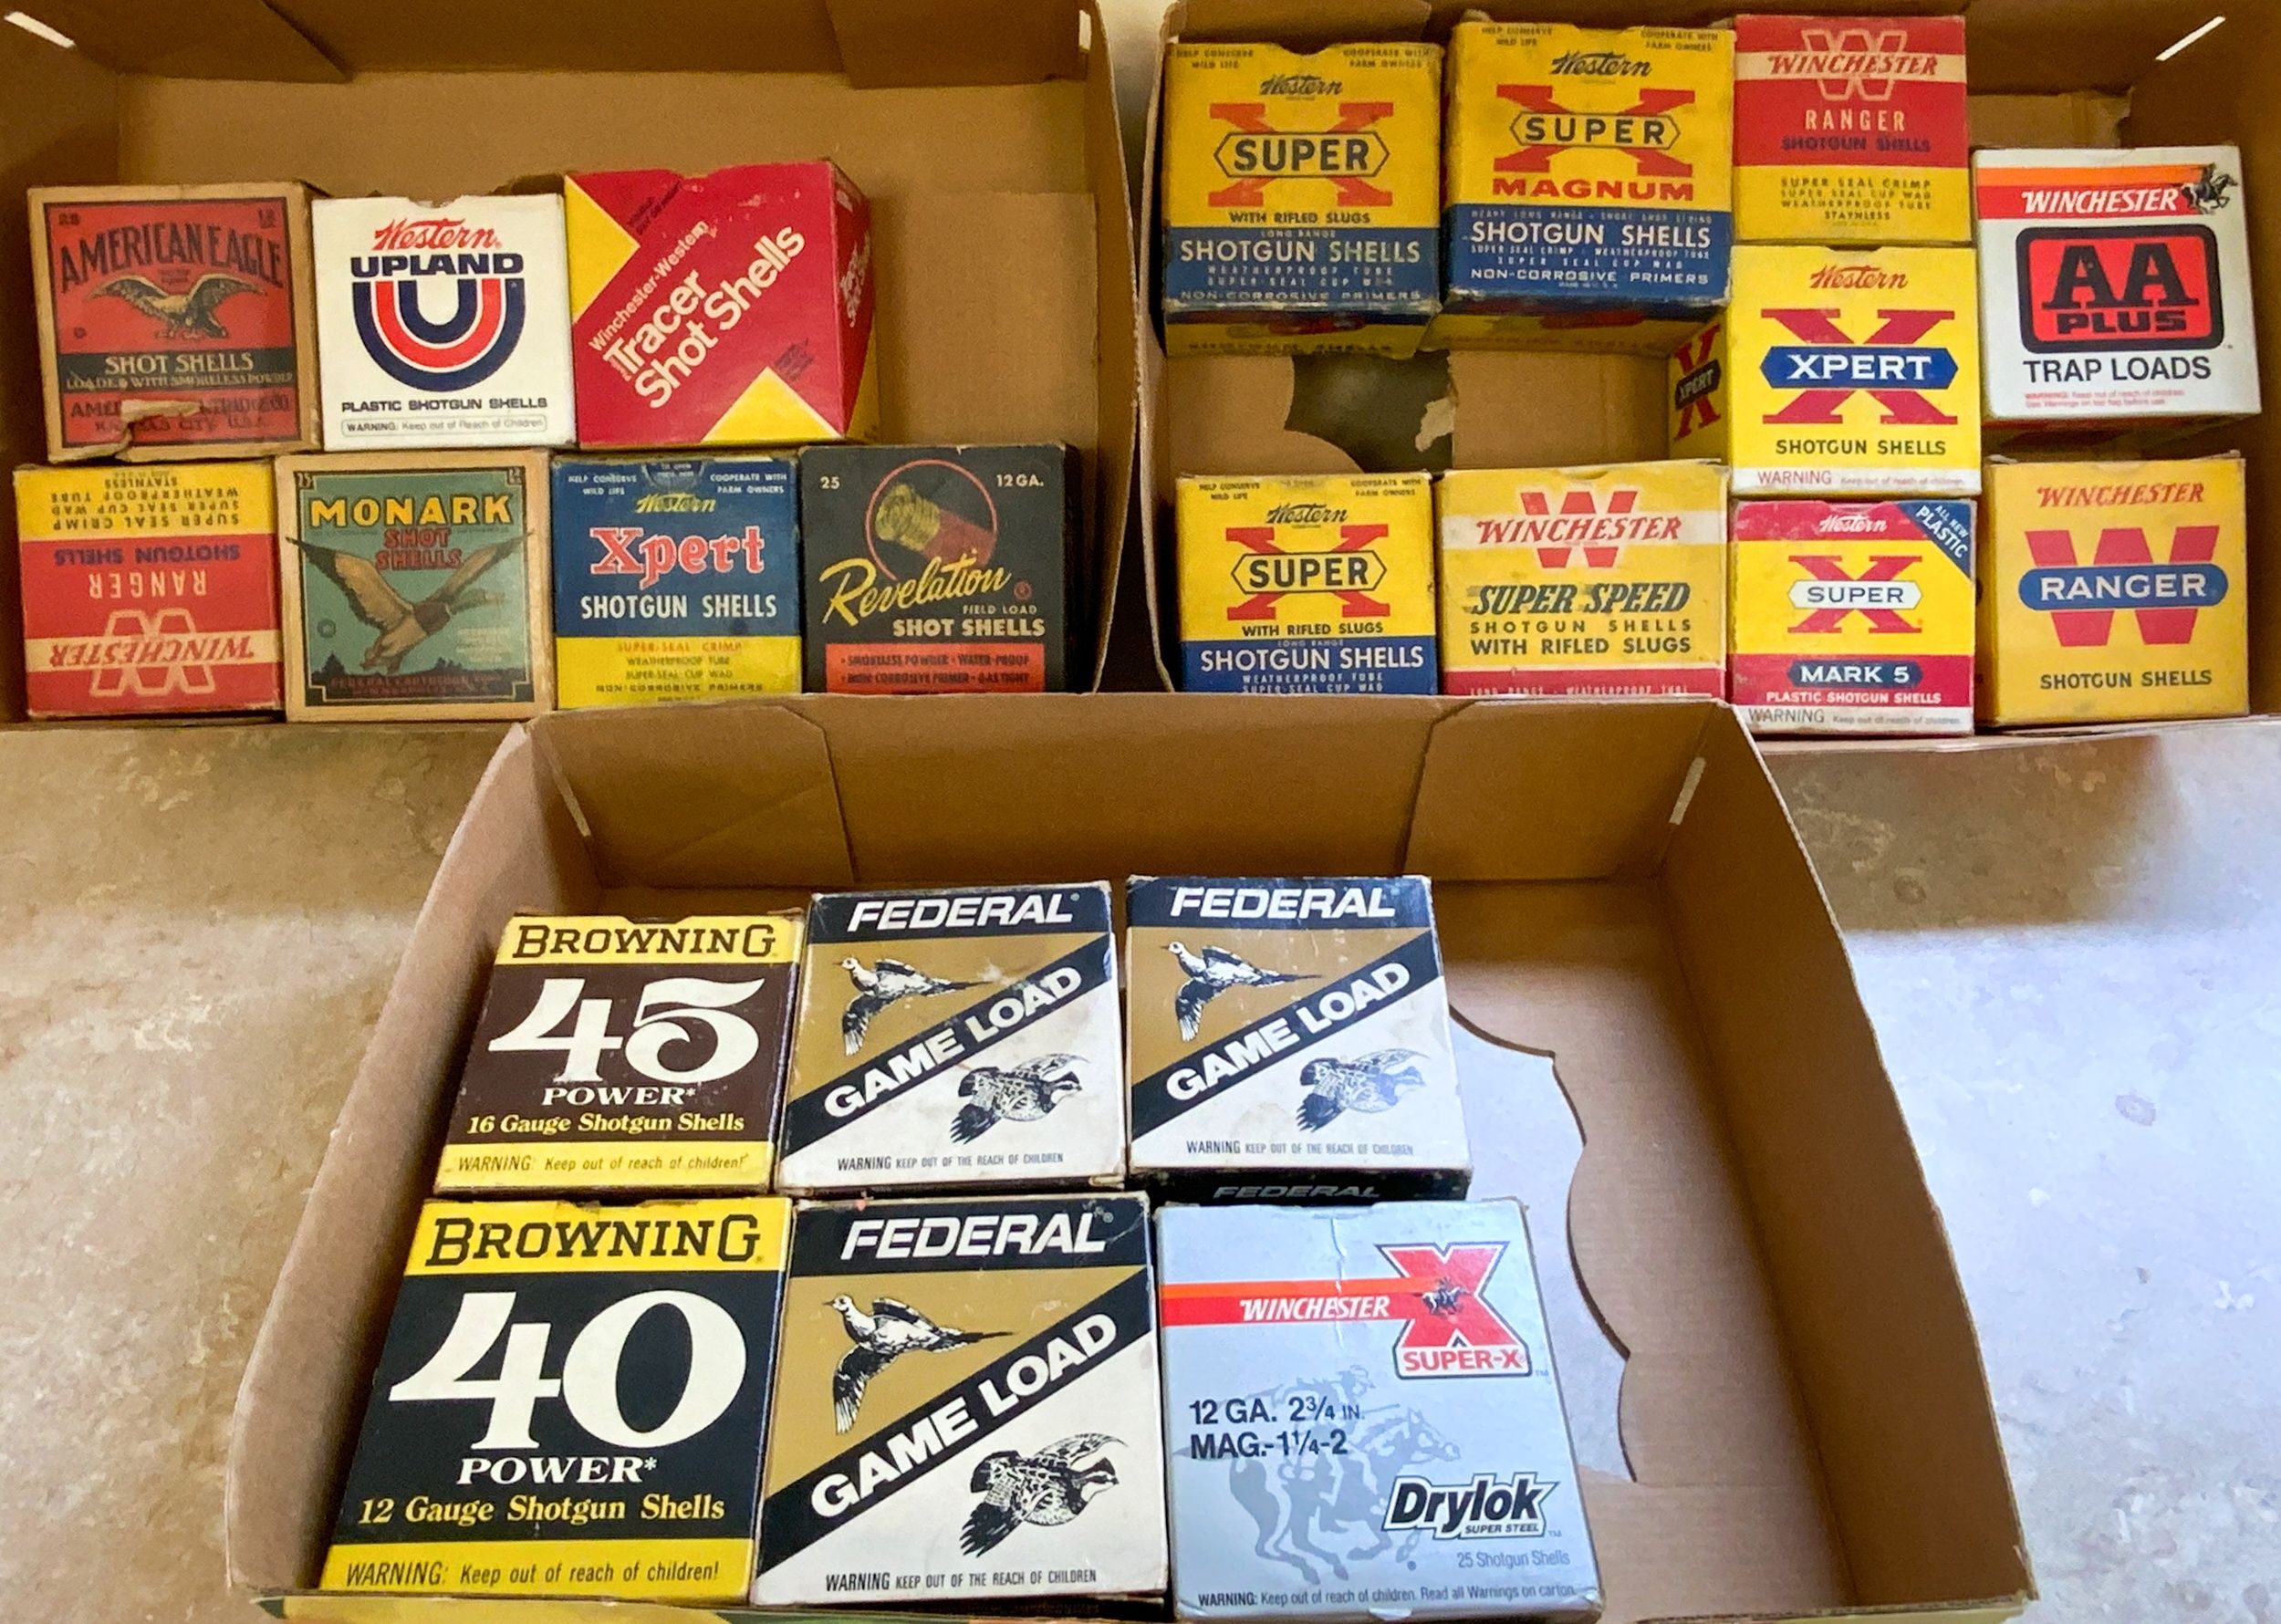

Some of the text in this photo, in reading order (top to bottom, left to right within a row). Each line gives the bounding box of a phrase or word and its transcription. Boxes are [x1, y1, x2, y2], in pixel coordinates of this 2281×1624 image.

[1768, 55, 1938, 75] WINCHESTER
[1526, 118, 1664, 144] SUPER
[1806, 109, 1905, 131] RANGER
[1234, 139, 1369, 171] SUPER
[1493, 179, 1693, 201] MAGNUM
[2021, 188, 2179, 213] WINCHESTER
[1231, 213, 1370, 223] WITH RIFLED SLUGS
[371, 218, 498, 250] Western
[1471, 222, 1710, 248] SHOTGUN SHELLS
[59, 223, 283, 292] AMERICAN EAGLE
[1181, 240, 1420, 263] SHOTGUN SHELLS
[351, 253, 524, 277] UPLAND
[1809, 265, 1908, 289] Western
[2042, 243, 2199, 310] AA
[588, 221, 709, 351] Winchester-Western
[1630, 273, 1709, 285] PRIMERS
[603, 269, 707, 374] Tracer
[635, 320, 718, 409] Shot
[704, 226, 806, 331] Shells
[2057, 311, 2186, 334] PLUS
[105, 352, 254, 375] SHOT SHELLS
[1786, 356, 1932, 381] XPERT
[2024, 356, 2212, 383] TRAP LOADS
[1679, 370, 1714, 400] XPERT
[342, 398, 547, 411] PLASTIC SHOTGUN SHELLS
[1776, 439, 1946, 455] SHOTGUN SHELLS
[105, 477, 177, 488] STAYNLESS
[821, 474, 1044, 489] 25 12 GA.
[1757, 471, 1832, 485] WARNING
[2037, 483, 2204, 507] WINCHESTER
[310, 496, 513, 526] MONARK
[1934, 505, 1969, 539] ALL NEW
[384, 527, 451, 547] SHOT
[1476, 516, 1682, 544] WINCHESTER
[1915, 505, 1968, 558] PLASTIC
[376, 549, 463, 570] SHELLS
[589, 526, 765, 590] Xpert
[89, 570, 206, 599] RANGER
[1250, 557, 1369, 588] SUPER
[819, 547, 1012, 627] Revelation
[1468, 582, 1691, 615] SUPER SPEED
[1807, 587, 1903, 603] SUPER
[2040, 574, 2206, 601] RANGER
[581, 594, 776, 619] SHOTGUN SHELLS
[963, 605, 1036, 614] FIELD LOAD
[893, 619, 1046, 637] SHOT SHELLS
[1242, 622, 1383, 637] WITH RIFLED SLUGS
[1471, 619, 1692, 634] SHOTGUN SHELLS
[49, 636, 254, 667] WINCHESTER
[1201, 646, 1423, 671] SHOTGUN SHELLS
[1472, 638, 1692, 655] WITH RIFLED SLUGS
[1801, 666, 1910, 682] MARK 5
[2040, 670, 2212, 690] SHOTGUN SHELLS
[1766, 692, 1942, 703] PLASTIC SHOTGUN SHELLS
[1748, 708, 1824, 722] WARNING
[847, 893, 1073, 932] FEDERAL
[1170, 887, 1395, 919] FEDERAL
[512, 924, 776, 959] BROWNING
[488, 977, 766, 1083] 45
[1166, 963, 1410, 1100] GAME LOAD
[824, 967, 1082, 1119] GAME LOAD
[466, 1112, 745, 1134] 16 Gauge Shotgun Shells
[1186, 1141, 1413, 1155] WARNING KEEP OUT OF THE REACH OF CHILDREN
[458, 1155, 745, 1171] WARNING: Keep out of reach of children!
[838, 1152, 1063, 1171] WARNING KEEP OUT OF THE REACH OF CHILDREN
[425, 1214, 762, 1266] BROWNING
[840, 1213, 1105, 1260] FEDERAL
[1240, 1296, 1390, 1322] WINCHESTER
[389, 1290, 746, 1450] 40
[1402, 1348, 1524, 1370] SUPER-X
[811, 1313, 1117, 1517] GAME LOAD
[1190, 1399, 1365, 1425] 12 GA. IN.
[359, 1494, 725, 1526] 12 Gauge Shotgun Shells
[1390, 1480, 1541, 1537] Drylok
[1465, 1523, 1539, 1534] SUPER STEEL
[1457, 1551, 1570, 1570] 25 Shotgun Shells
[346, 1561, 718, 1587] WARNING: Keep out of reach of children!
[826, 1569, 1096, 1591] WARNING KEEP OUT OF THE REACH OF CHILDREN
[1198, 1593, 1257, 1607] WARNING:
[1261, 1592, 1287, 1608] Keep
[1291, 1592, 1308, 1604] out
[1312, 1590, 1322, 1603] of
[1325, 1590, 1355, 1603] reach
[1358, 1589, 1369, 1602] of
[1421, 1587, 1449, 1600] Read
[1453, 1586, 1464, 1599] all
[1467, 1584, 1518, 1600] Warnings
[1522, 1586, 1536, 1598] on
